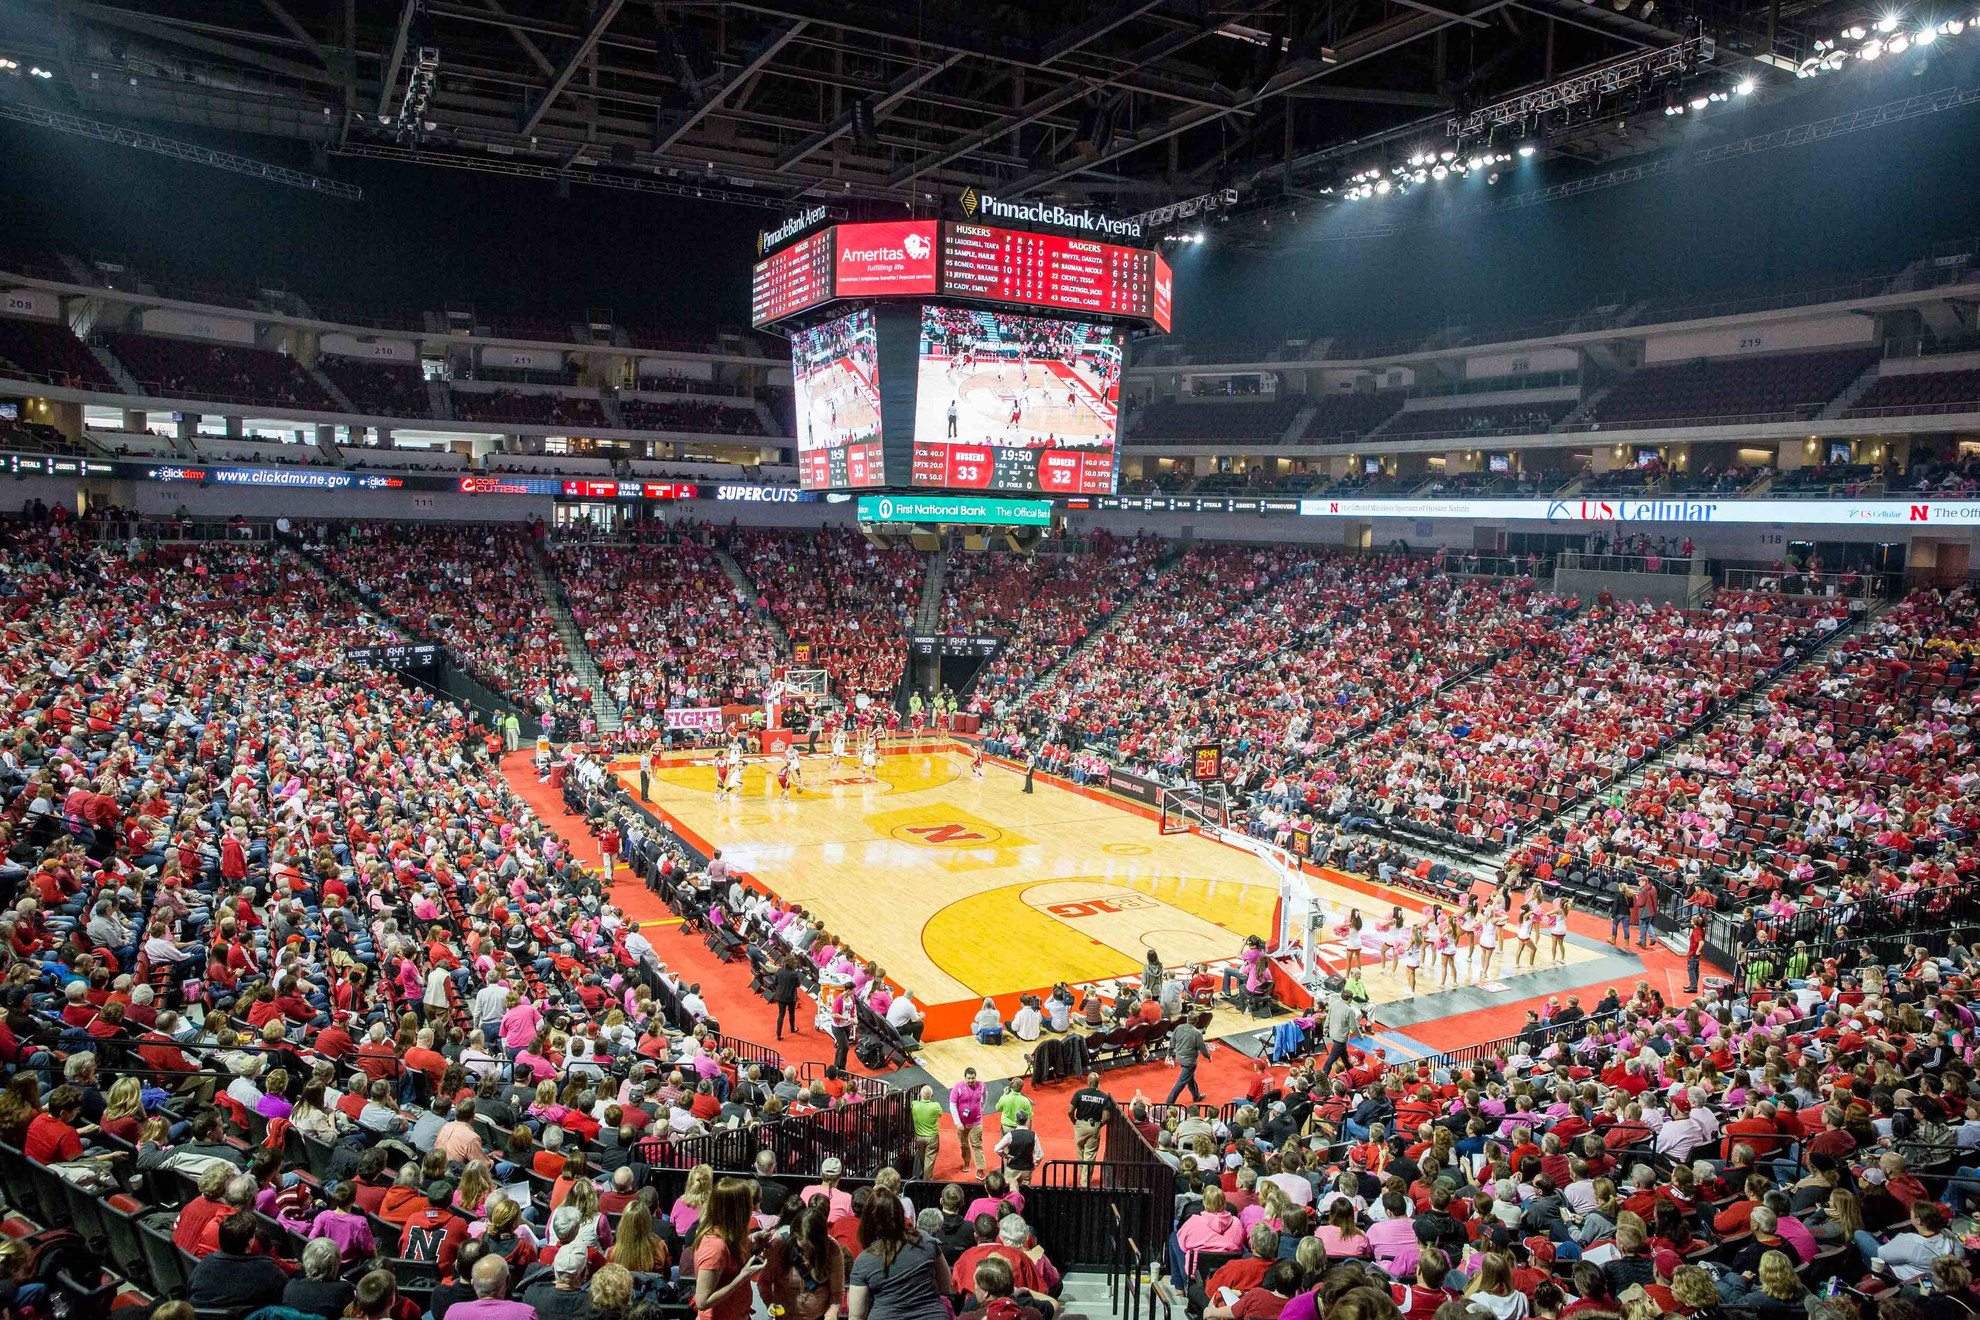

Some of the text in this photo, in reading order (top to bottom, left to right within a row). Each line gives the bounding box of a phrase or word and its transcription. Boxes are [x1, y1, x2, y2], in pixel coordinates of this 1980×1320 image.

[981, 195, 1141, 237] PinnacleBank Arena
[763, 205, 826, 249] PinnacleBank Arena
[956, 225, 990, 236] HUSKERS
[1069, 241, 1101, 252] BADGERS
[842, 248, 903, 262] Ameritas
[1123, 260, 1128, 268] 0
[1003, 266, 1012, 274] 10
[1123, 271, 1128, 279] 5
[9, 299, 32, 310] 208
[1740, 337, 1761, 348] 219
[374, 347, 393, 355] 210
[514, 356, 532, 364] 211
[1000, 449, 1032, 462] 19:50
[20, 461, 41, 469] STEALS
[56, 463, 76, 471] ASSISTS
[854, 464, 863, 477] 32
[162, 469, 205, 479] clickdmv
[217, 470, 350, 487] www.clickdmv.ne.gov
[816, 469, 824, 481] 33
[957, 466, 977, 480] 33
[1052, 470, 1071, 483] 32
[999, 480, 1003, 488] 0
[717, 486, 799, 502] SUPERCUTS
[896, 503, 1037, 518] First National Bank The Official
[1330, 503, 1338, 513] N
[1620, 500, 1717, 521] Cellular
[1910, 505, 1929, 521] N
[1934, 508, 1958, 518] The
[1760, 535, 1782, 544] 118
[922, 645, 931, 653] 33
[422, 655, 431, 664] 32
[797, 652, 808, 661] 20
[664, 711, 721, 727] FIGHT
[1200, 749, 1217, 758] 19:49
[1199, 760, 1214, 775] 20
[905, 824, 989, 843] N
[1081, 1095, 1104, 1104] SECURITY
[404, 1225, 448, 1263] N
